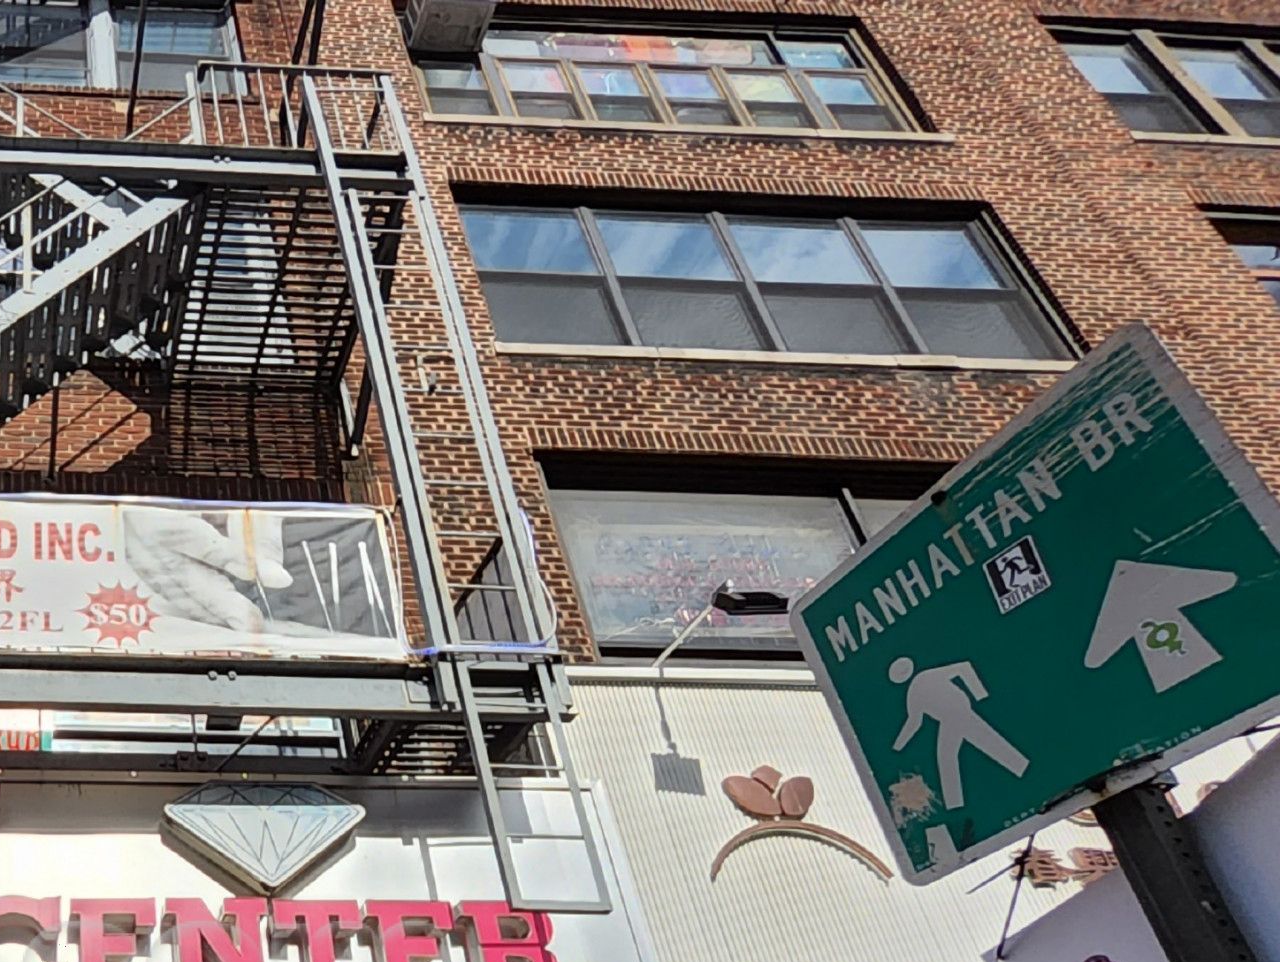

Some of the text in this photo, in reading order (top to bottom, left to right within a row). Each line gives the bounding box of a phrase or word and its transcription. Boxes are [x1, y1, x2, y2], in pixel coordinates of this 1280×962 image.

[33, 521, 115, 562] INC.
[824, 457, 1062, 662] MANHATTAN
[1072, 392, 1154, 472] BR
[90, 602, 148, 626] $50
